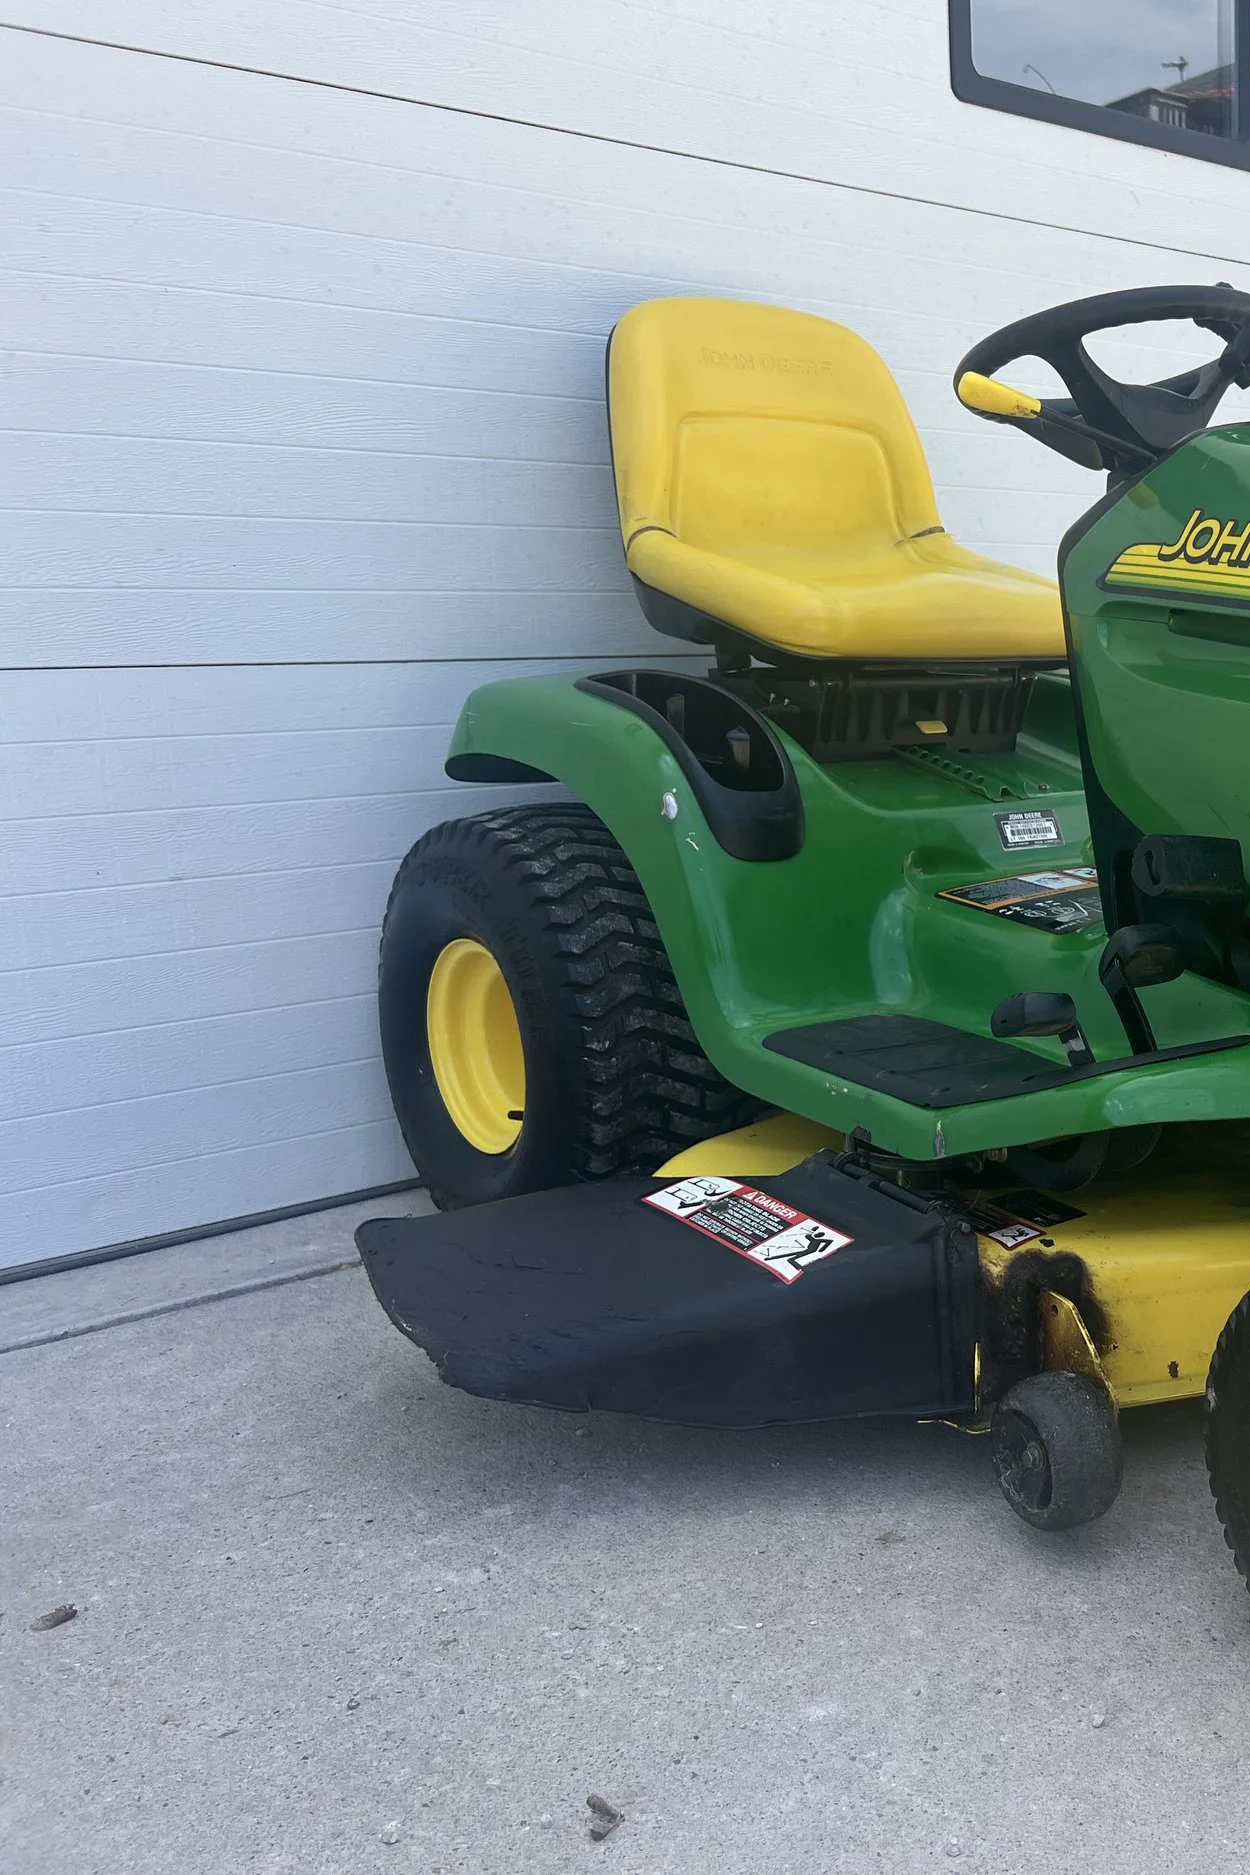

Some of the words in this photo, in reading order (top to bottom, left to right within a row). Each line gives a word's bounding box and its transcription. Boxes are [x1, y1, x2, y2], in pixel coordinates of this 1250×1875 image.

[697, 347, 754, 371] JOHN
[757, 351, 833, 377] DEERE
[753, 1196, 797, 1219] DANGER
